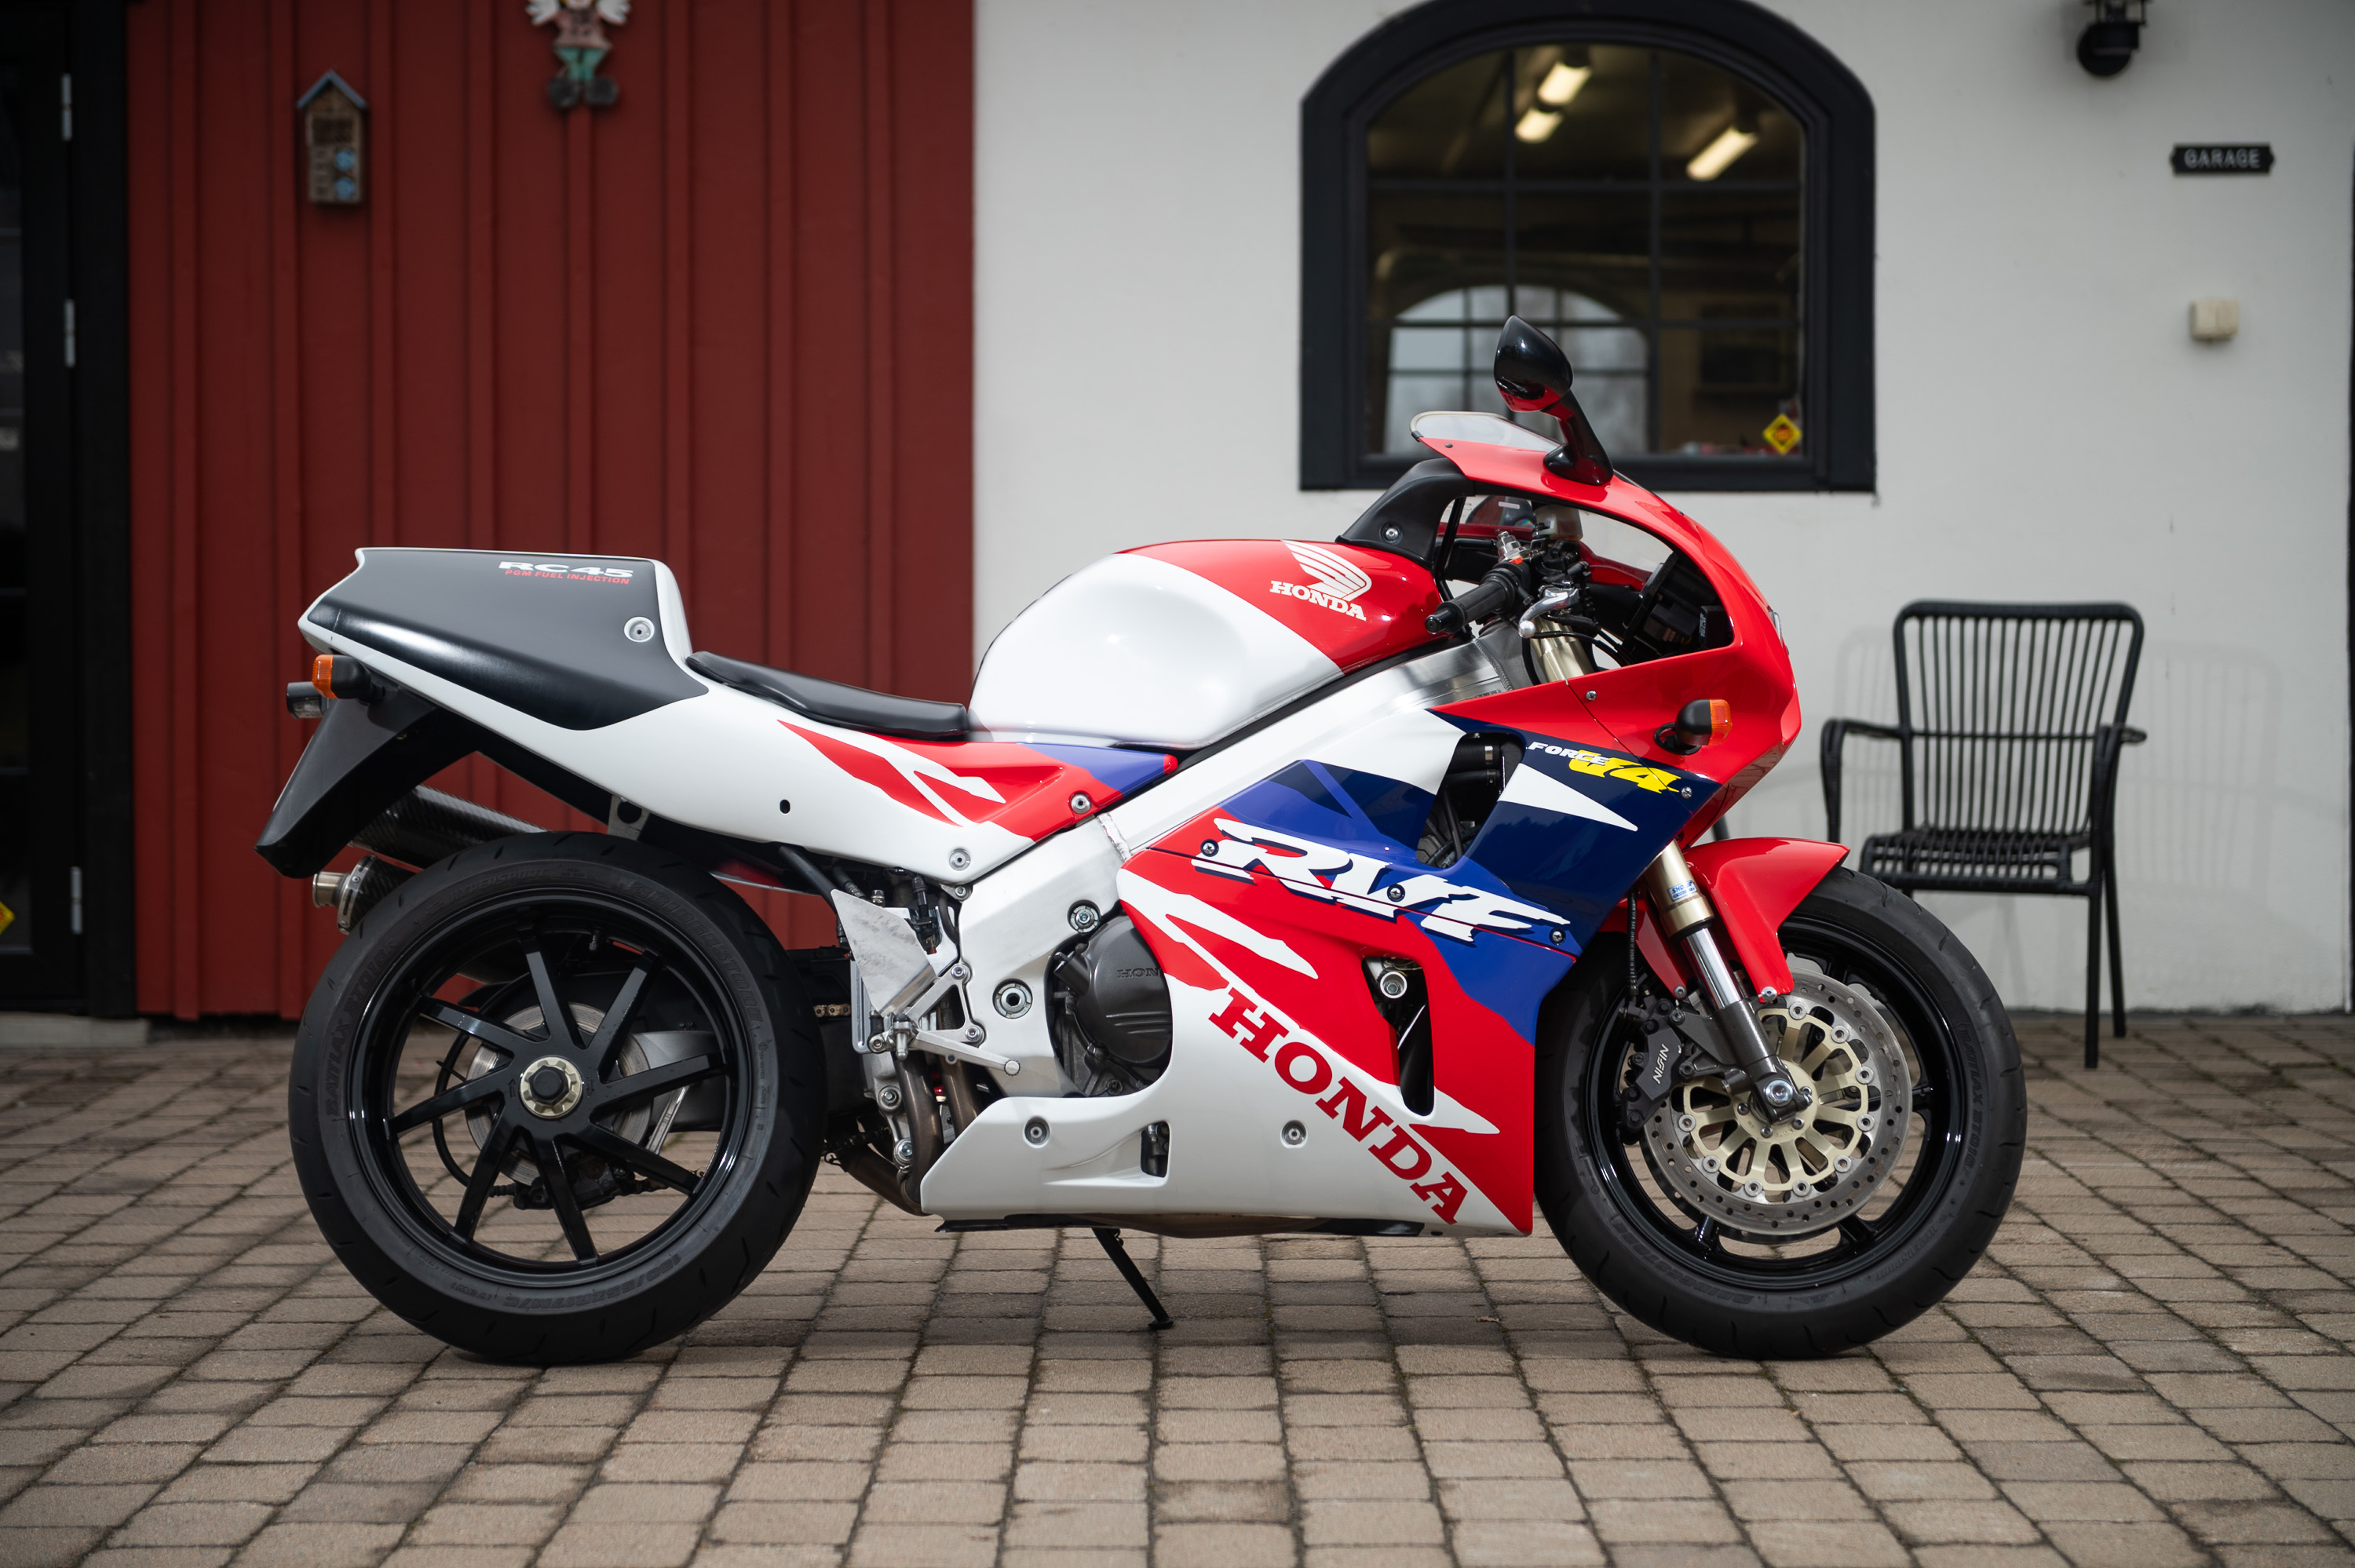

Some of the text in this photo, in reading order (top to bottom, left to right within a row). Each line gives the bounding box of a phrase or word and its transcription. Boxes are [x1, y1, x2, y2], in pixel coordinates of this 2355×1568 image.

[2184, 148, 2261, 169] GARAGE
[498, 561, 633, 578] RC45
[535, 571, 564, 579] FUEL
[567, 573, 630, 585] INJECTION
[1269, 580, 1367, 622] HONDA
[1528, 741, 1610, 766] FORCE
[1568, 749, 1681, 794] V4
[1191, 818, 1571, 946] RVF
[628, 881, 761, 1024] BRIDGESTONE
[325, 1018, 352, 1118] BATTLAX
[1652, 1044, 1670, 1085] NISSIN
[1959, 1027, 1983, 1105] BATTLAX
[1208, 987, 1468, 1225] HONDA
